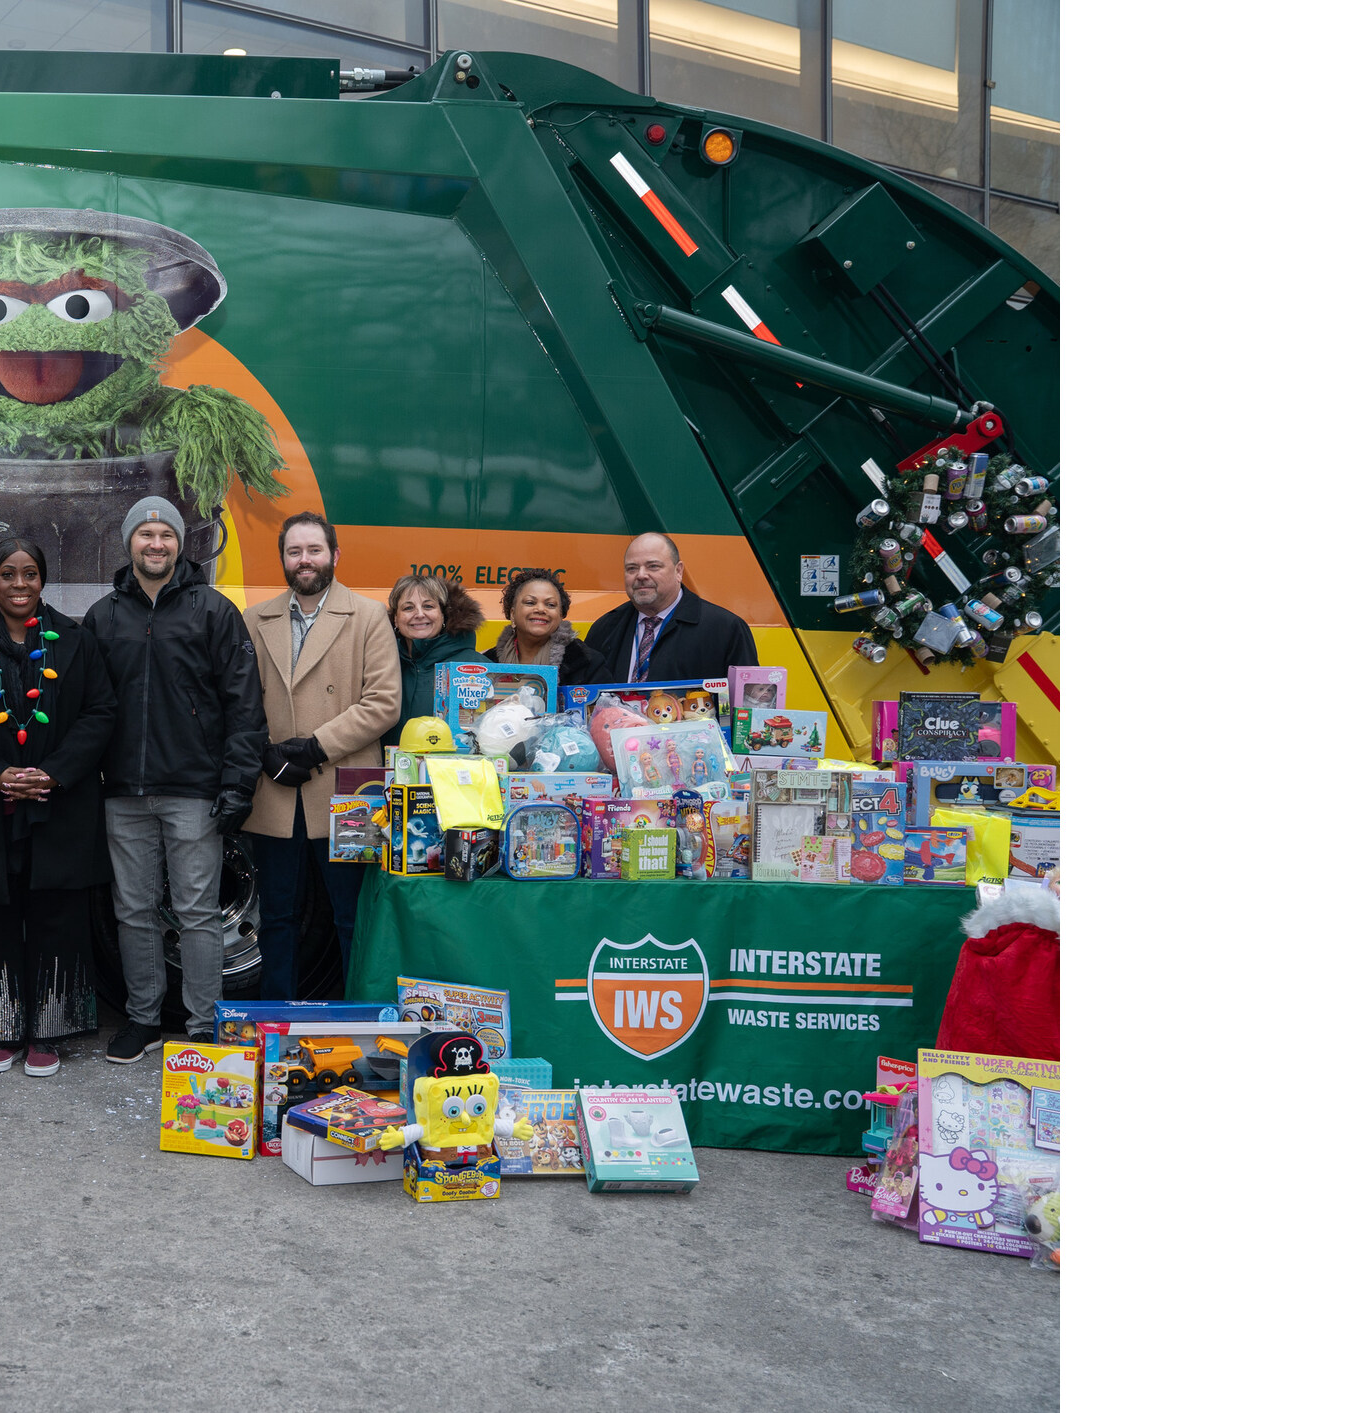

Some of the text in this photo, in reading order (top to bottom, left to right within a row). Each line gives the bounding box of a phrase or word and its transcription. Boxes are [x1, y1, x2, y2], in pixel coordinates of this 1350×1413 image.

[458, 687, 485, 698] Mixer
[465, 698, 477, 706] Set
[924, 717, 960, 729] Clue
[917, 729, 967, 738] CONSPIRACY
[779, 773, 821, 786] STMT
[1032, 769, 1051, 780] 25+
[333, 801, 368, 813] HOT WHEELS
[880, 789, 899, 813] 4
[608, 804, 631, 812] Friends
[648, 835, 668, 846] should
[639, 856, 668, 870] that!
[609, 957, 688, 970] INTERSTATE
[729, 949, 882, 977] INTERSTATE
[405, 989, 441, 1000] SPIDEY
[443, 989, 504, 1004] SUPER ACTIVITY
[221, 1008, 247, 1019] Disney
[613, 990, 683, 1029] IWS
[477, 1011, 485, 1023] 3
[728, 1008, 880, 1032] WASTE SERVICES
[168, 1053, 214, 1072] Play-Doh
[881, 1059, 914, 1072] fisher-price
[941, 1058, 970, 1066] FRIENDS
[975, 1057, 1013, 1069] SUPER
[500, 1076, 530, 1085] NON-TOXIC
[307, 1095, 354, 1113] CONNECT
[1036, 1093, 1047, 1105] 3
[330, 1131, 355, 1144] CONNECT
[354, 1137, 360, 1148] 4
[851, 1167, 877, 1187] Barbi
[874, 1187, 901, 1203] Barbie
[974, 1233, 1006, 1242] CHARACTERS
